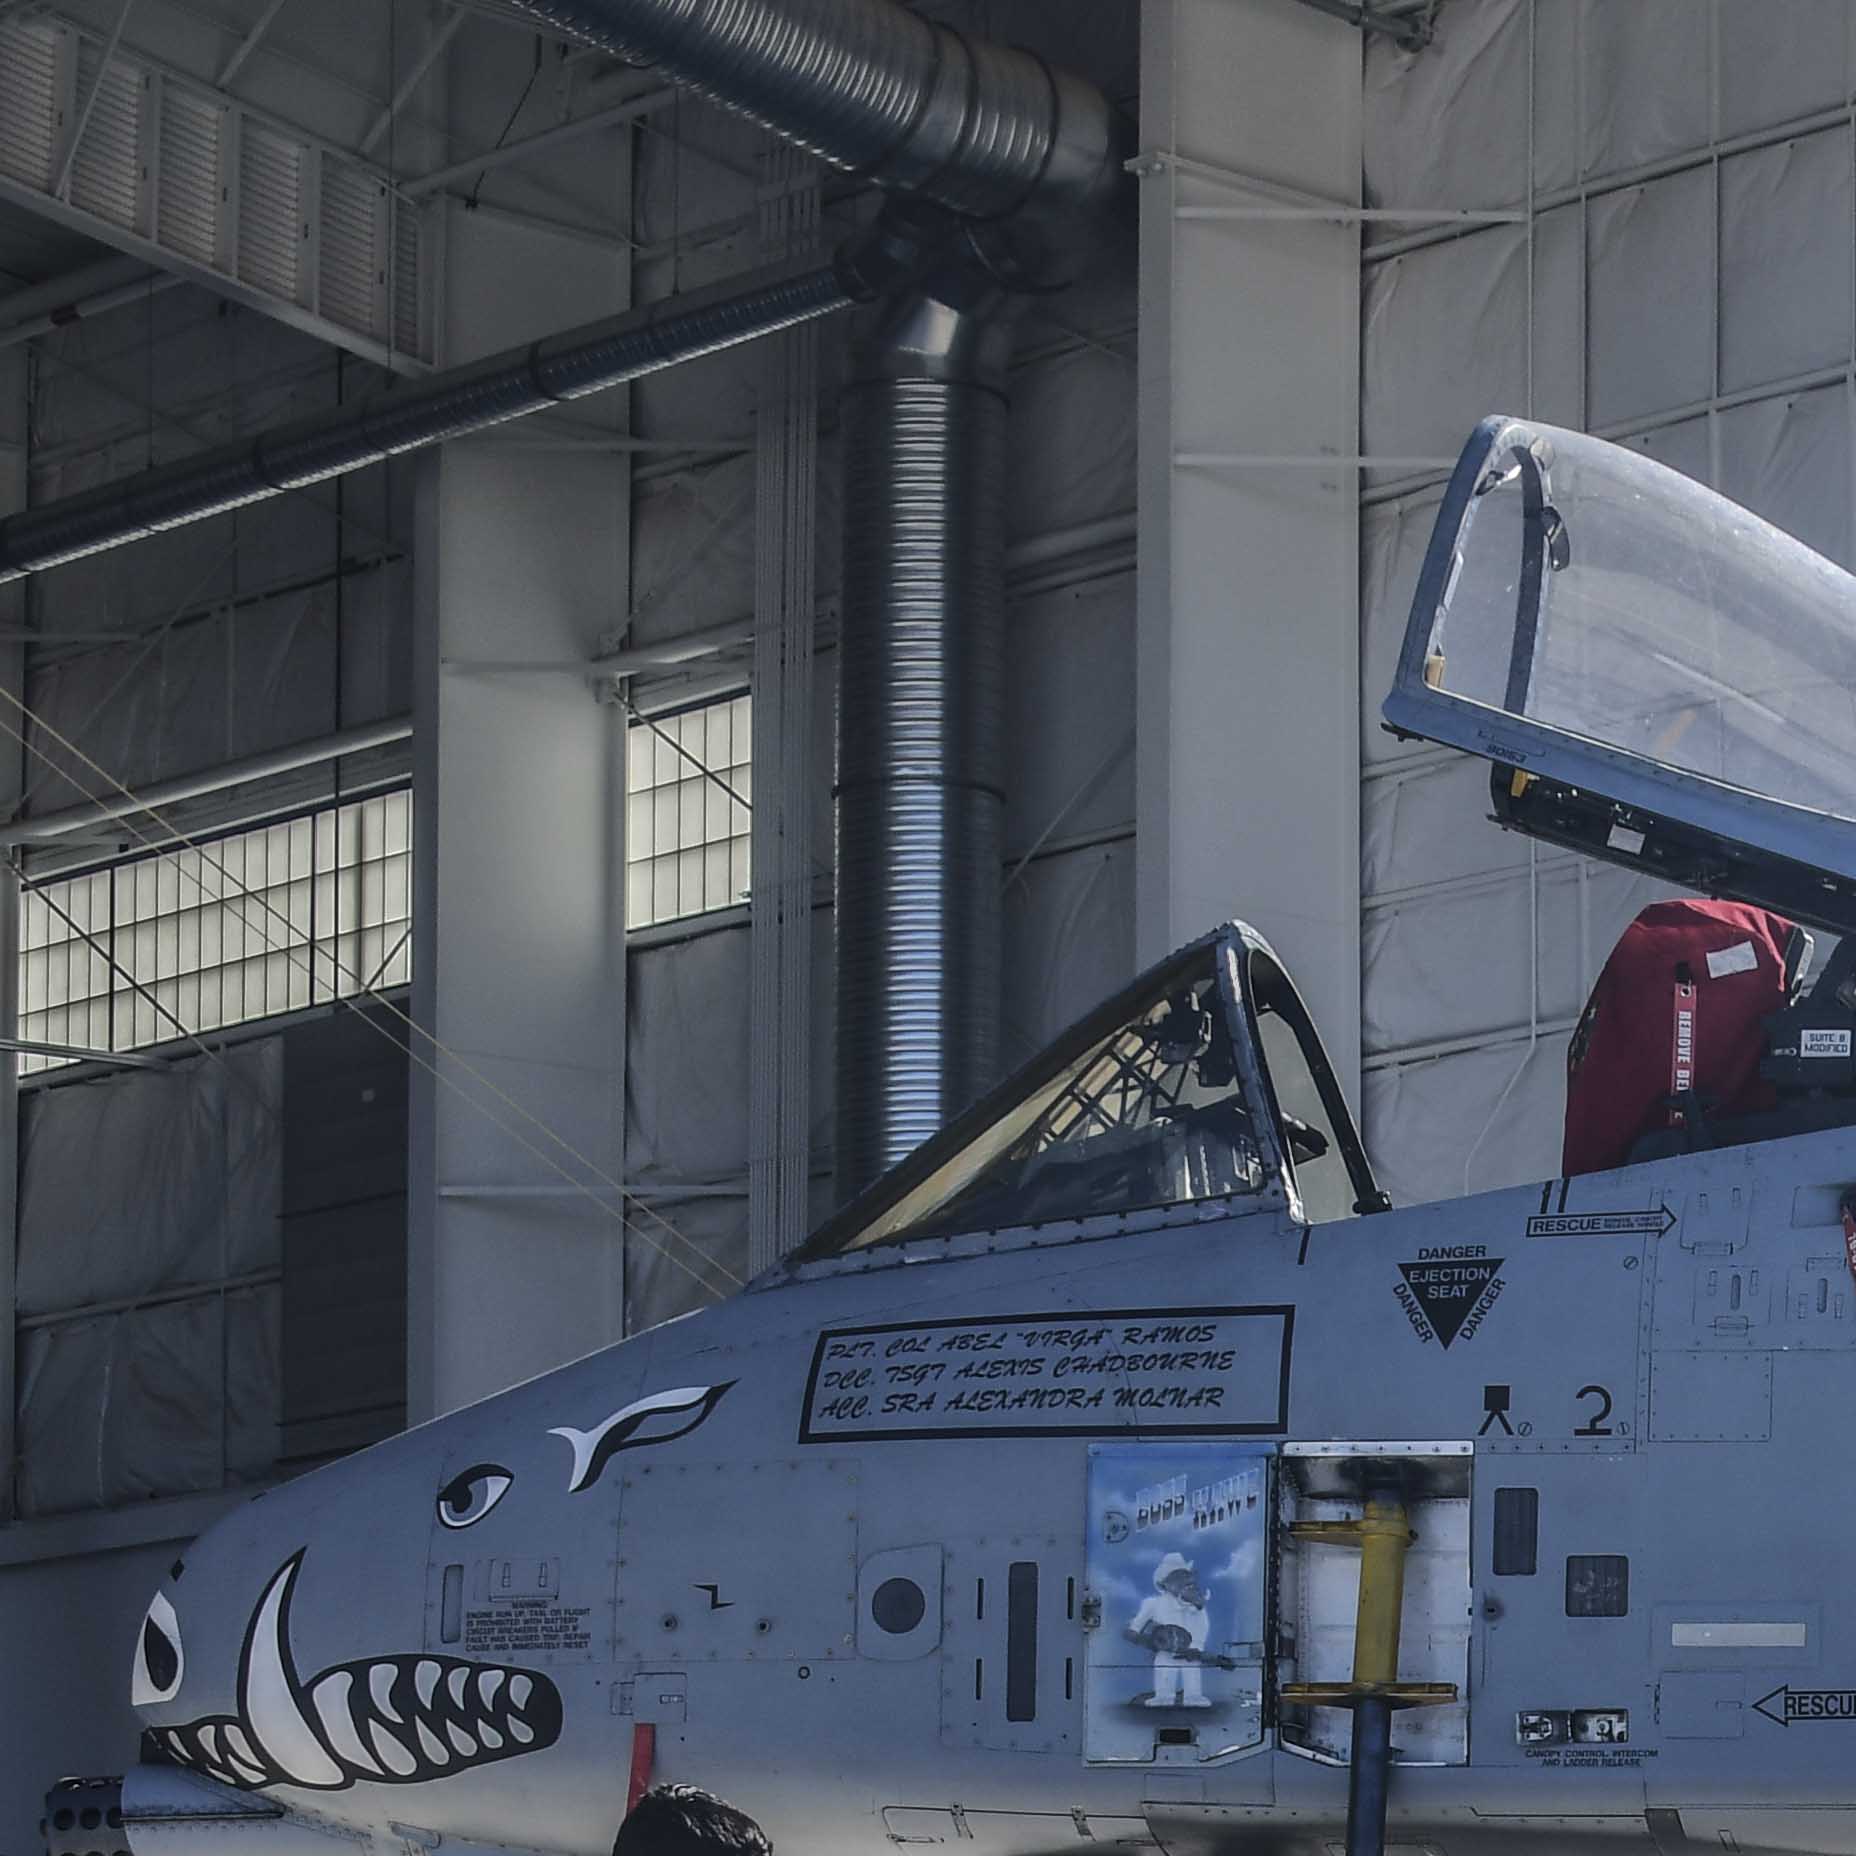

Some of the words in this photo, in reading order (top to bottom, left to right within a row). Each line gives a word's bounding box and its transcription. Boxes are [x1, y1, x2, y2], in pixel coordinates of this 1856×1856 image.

[1677, 1011, 1692, 1064] REMOVE
[1810, 1033, 1834, 1042] SUITE
[1805, 1044, 1848, 1053] MODIFIED
[1533, 1218, 1600, 1233] RESCUE
[1418, 1245, 1487, 1261] DANGER
[1409, 1267, 1491, 1283] EJECTION
[1427, 1284, 1470, 1299] SEAT
[1392, 1282, 1434, 1344] DANGER
[1459, 1277, 1506, 1341] DANGER
[826, 1339, 876, 1361] PLT.
[885, 1338, 930, 1358] COL
[937, 1332, 1008, 1353] ABEL
[1121, 1324, 1218, 1346] RAMOS
[823, 1370, 875, 1389] DCC.
[885, 1363, 947, 1385] TSGT
[952, 1357, 1045, 1381] ALEXIS
[1053, 1351, 1237, 1379] CHADBOURNE
[819, 1397, 873, 1419] ACC.
[880, 1393, 934, 1414] SRA
[944, 1387, 1103, 1413] ALEXANDRA
[1113, 1386, 1226, 1410] MOLNAR
[1525, 1750, 1561, 1758] CANOPY
[1612, 1749, 1658, 1757] INTERCOM
[1541, 1758, 1560, 1767] AND
[1563, 1758, 1600, 1767] LADDER
[1601, 1758, 1642, 1767] RELEASE
